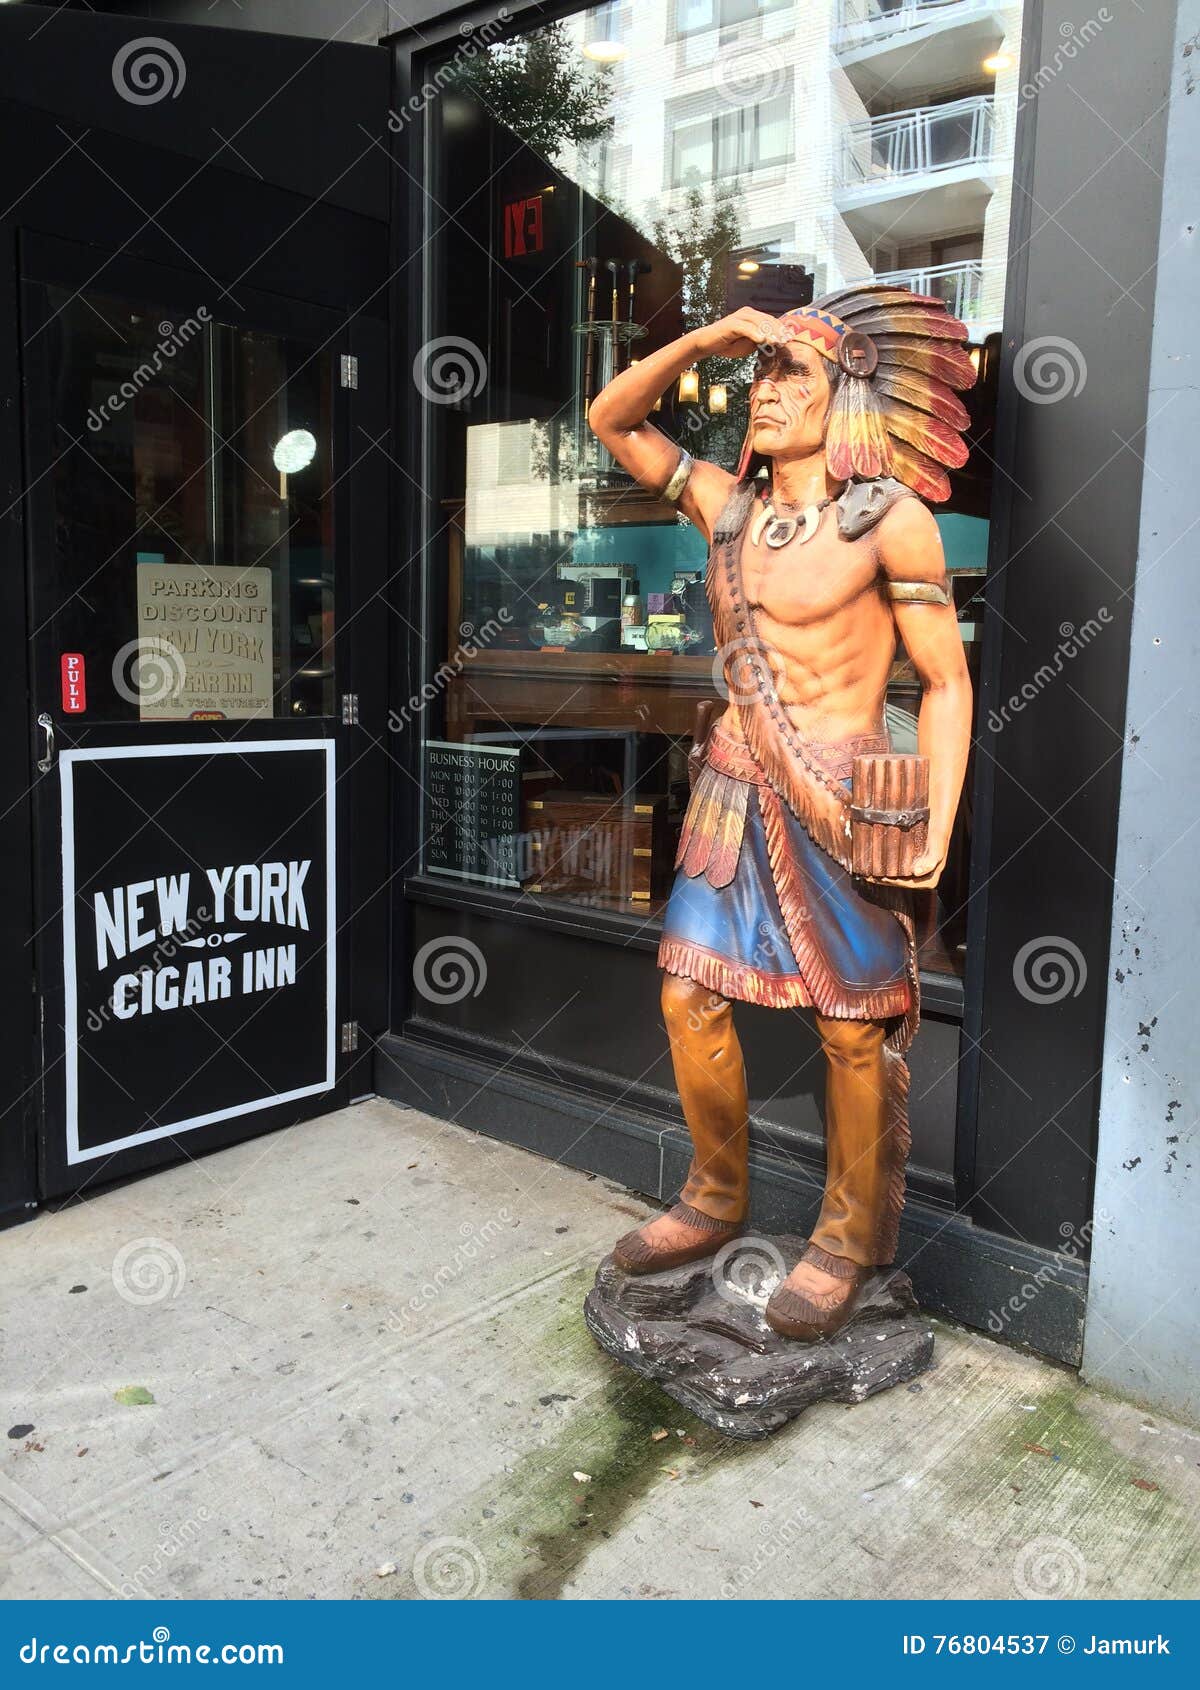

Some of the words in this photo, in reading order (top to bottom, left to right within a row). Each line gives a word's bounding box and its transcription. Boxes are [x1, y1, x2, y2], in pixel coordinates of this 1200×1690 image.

[152, 578, 258, 598] PARKING
[143, 603, 267, 623] DISCOUNT
[151, 628, 198, 660] NEW
[207, 628, 264, 665] YORK
[66, 656, 80, 710] PULL
[222, 671, 253, 693] INN
[430, 752, 475, 768] BUSINESS
[478, 757, 516, 773] HOURS
[431, 771, 450, 781] MON
[454, 772, 475, 783] 10:00
[431, 784, 446, 794] TUE
[455, 787, 476, 797] 10:00
[492, 791, 513, 803] 1:00
[431, 796, 449, 807] WED
[454, 799, 476, 810] 10:00
[492, 805, 513, 817] 1:00
[431, 809, 448, 820] THU
[454, 813, 476, 825] 10:00
[492, 818, 513, 831] 1:00
[431, 823, 444, 833] FRI
[431, 836, 445, 846] SAT
[431, 848, 448, 859] SUN
[94, 872, 190, 971] NEW
[206, 860, 312, 931] YORK
[113, 956, 232, 1020] CIGAR
[242, 944, 296, 994] INN
